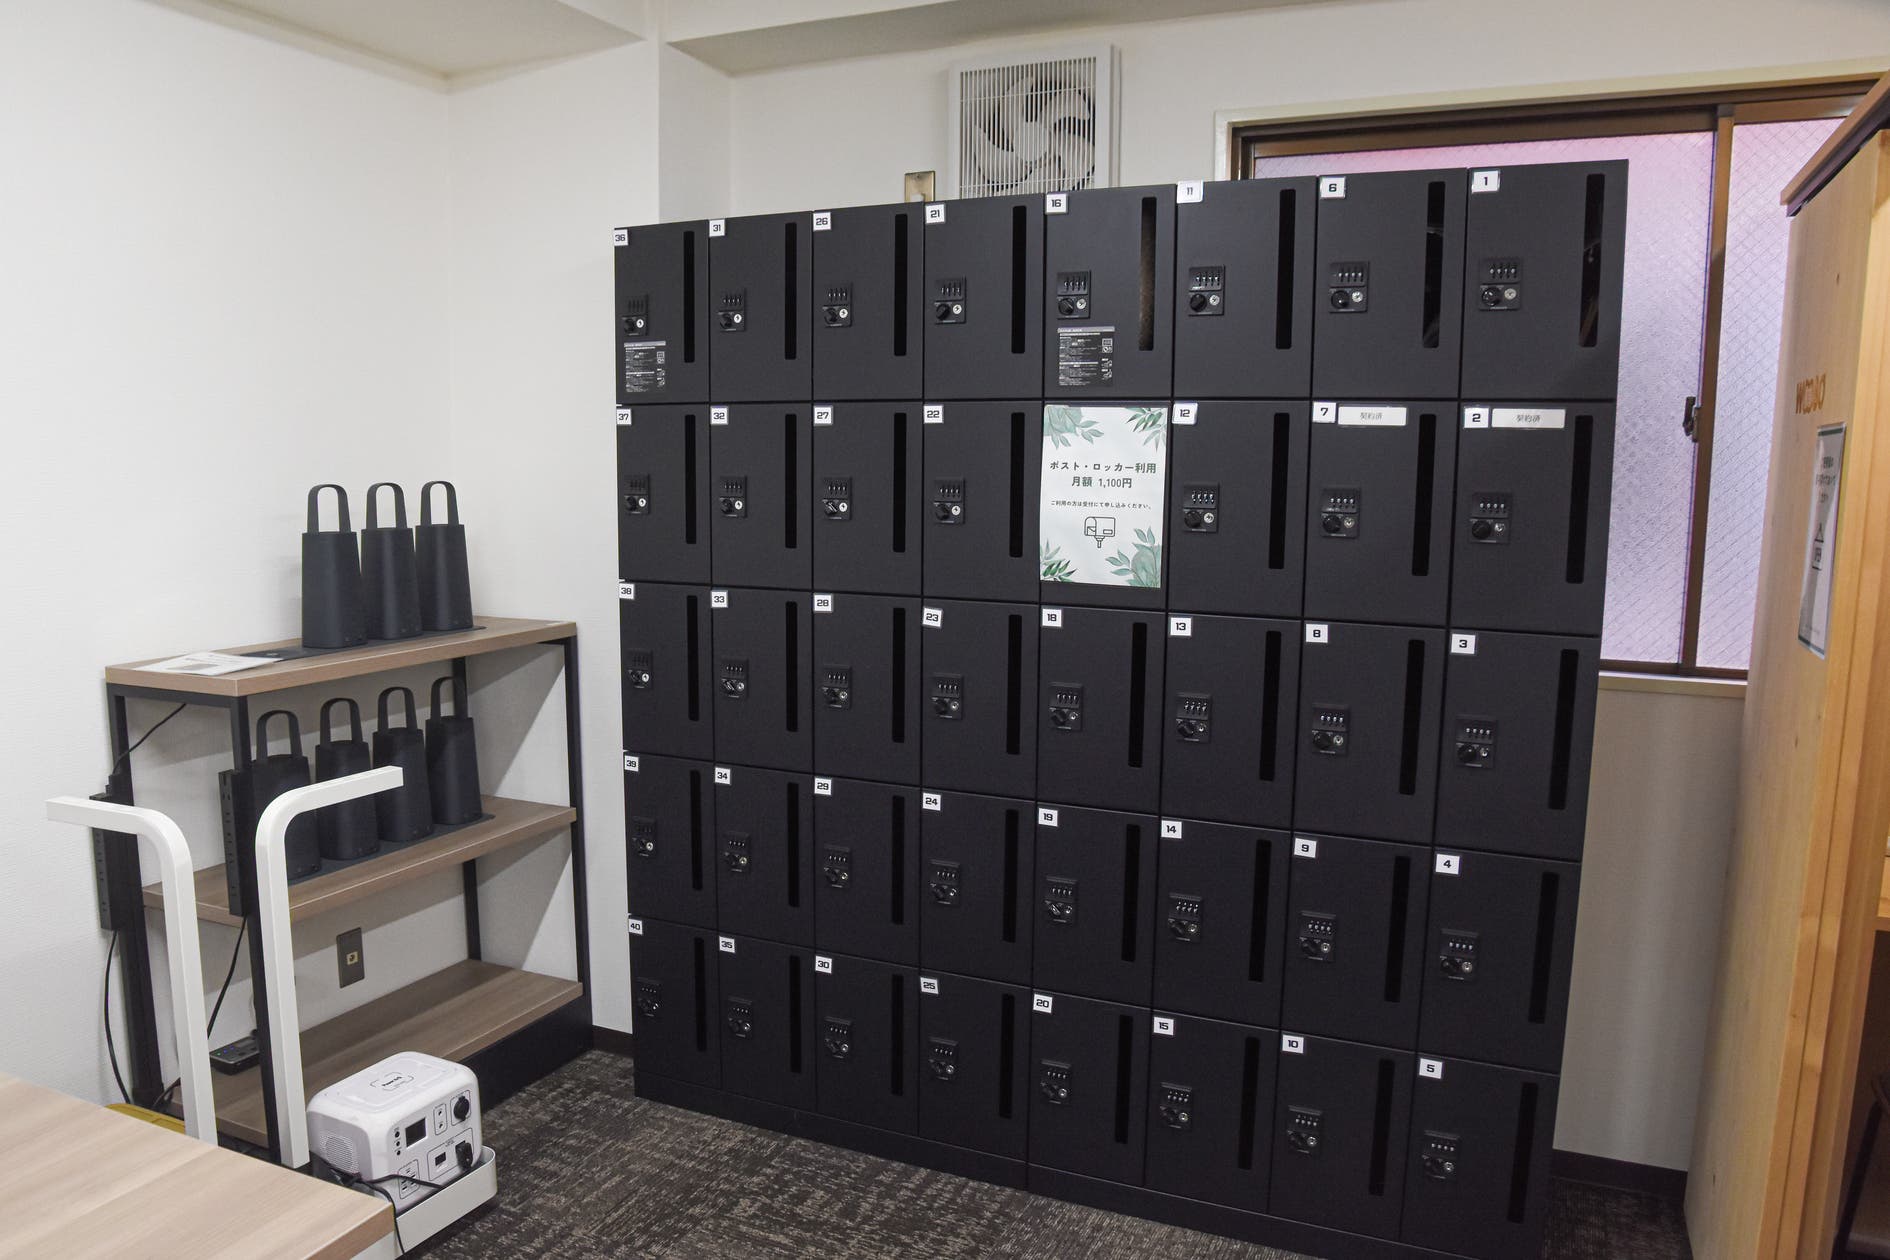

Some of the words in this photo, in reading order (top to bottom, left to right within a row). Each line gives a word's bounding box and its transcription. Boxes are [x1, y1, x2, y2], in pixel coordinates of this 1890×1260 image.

[1186, 186, 1194, 195] 11
[1328, 183, 1338, 193] 6
[1050, 199, 1062, 207] 16
[930, 209, 941, 219] 21
[815, 217, 829, 226] 26
[712, 224, 722, 232] 31
[615, 234, 626, 242] 36
[713, 412, 725, 420] 32
[816, 411, 830, 420] 27
[926, 410, 940, 419] 22
[1179, 408, 1191, 418] 12
[1320, 407, 1329, 417] 7
[618, 413, 629, 421] 37
[1471, 413, 1482, 423] 2
[1049, 460, 1157, 474] ポスト・ロッカー利用
[1071, 476, 1093, 487] 月額
[1098, 478, 1133, 489] 1,100円
[620, 587, 632, 595] 38
[713, 595, 725, 604] 33
[816, 599, 829, 607] 28
[925, 612, 939, 623] 23
[1046, 613, 1058, 622] 18
[1175, 622, 1187, 631] 13
[1312, 629, 1322, 638] 8
[1458, 639, 1468, 649] 3
[626, 760, 637, 769] 39
[717, 771, 728, 780] 34
[817, 781, 829, 791] 29
[925, 796, 938, 806] 24
[1043, 812, 1054, 822] 19
[1166, 824, 1177, 834] 14
[1300, 843, 1310, 853] 9
[1443, 859, 1452, 869] 4
[630, 923, 641, 931] 40
[722, 940, 732, 949] 35
[817, 959, 830, 969] 30
[923, 981, 936, 990] 25
[1036, 998, 1050, 1009] 20
[1158, 1021, 1169, 1031] 15
[1287, 1039, 1299, 1049] 10
[1426, 1063, 1436, 1073] 5
